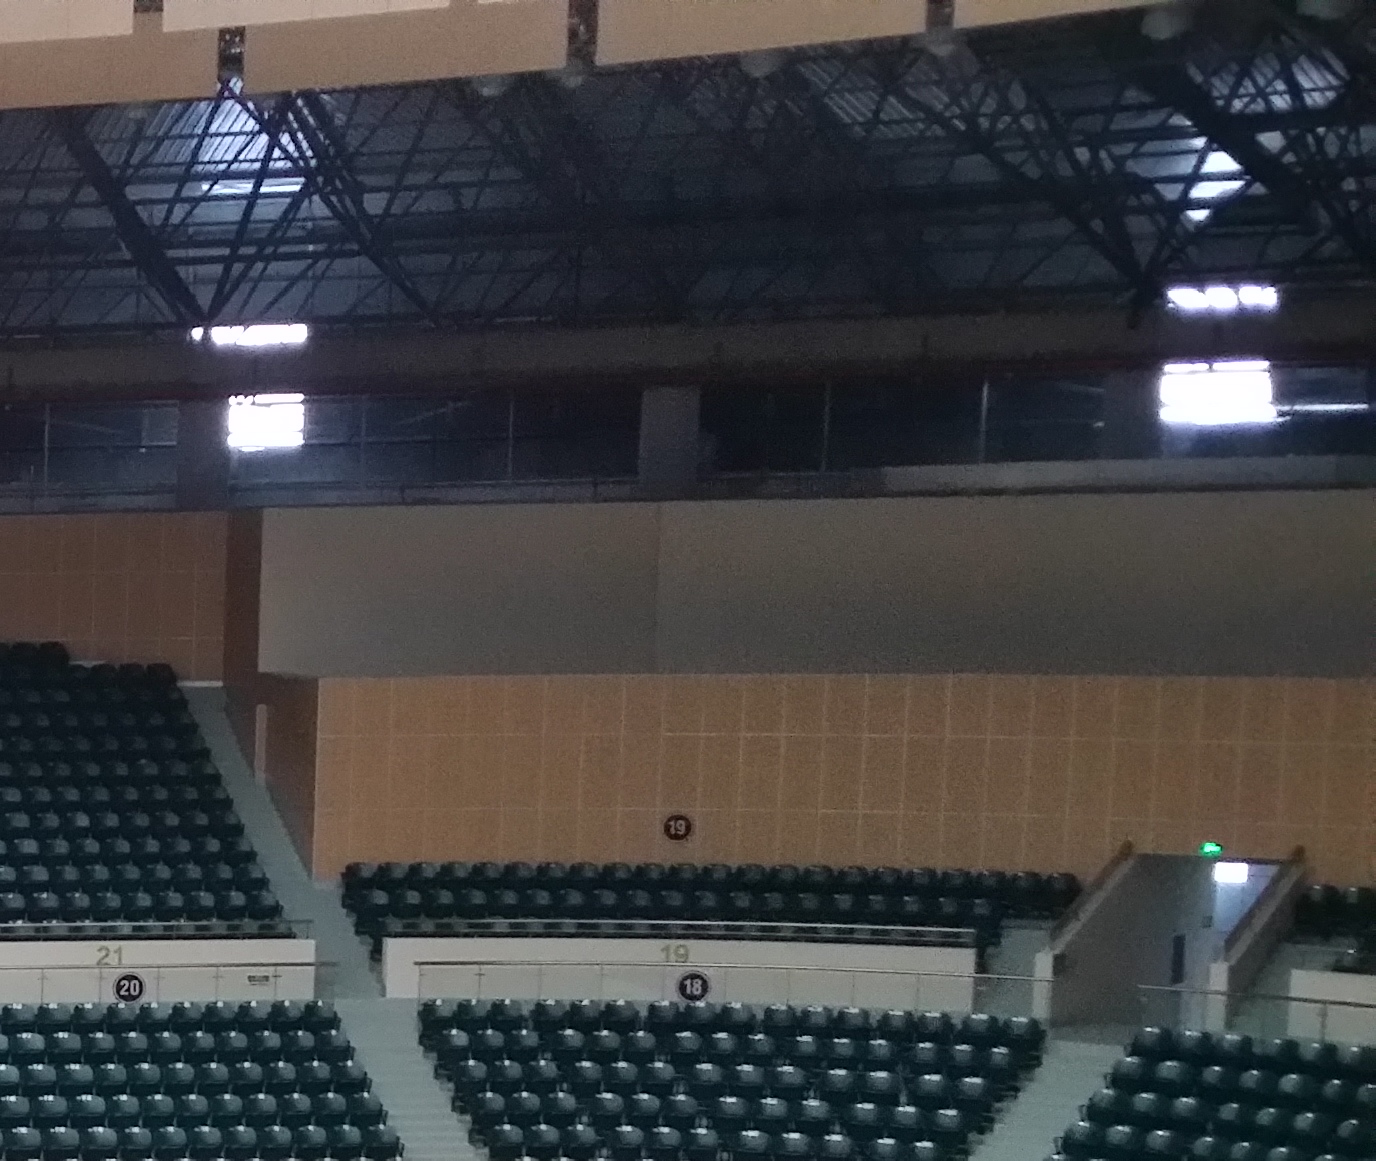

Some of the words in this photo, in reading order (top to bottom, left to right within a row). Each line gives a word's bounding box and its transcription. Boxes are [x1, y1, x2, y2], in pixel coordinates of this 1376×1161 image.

[668, 819, 686, 836] 19
[95, 945, 124, 966] 21
[659, 943, 690, 963] 19
[119, 978, 140, 996] 20
[683, 978, 703, 996] 18
